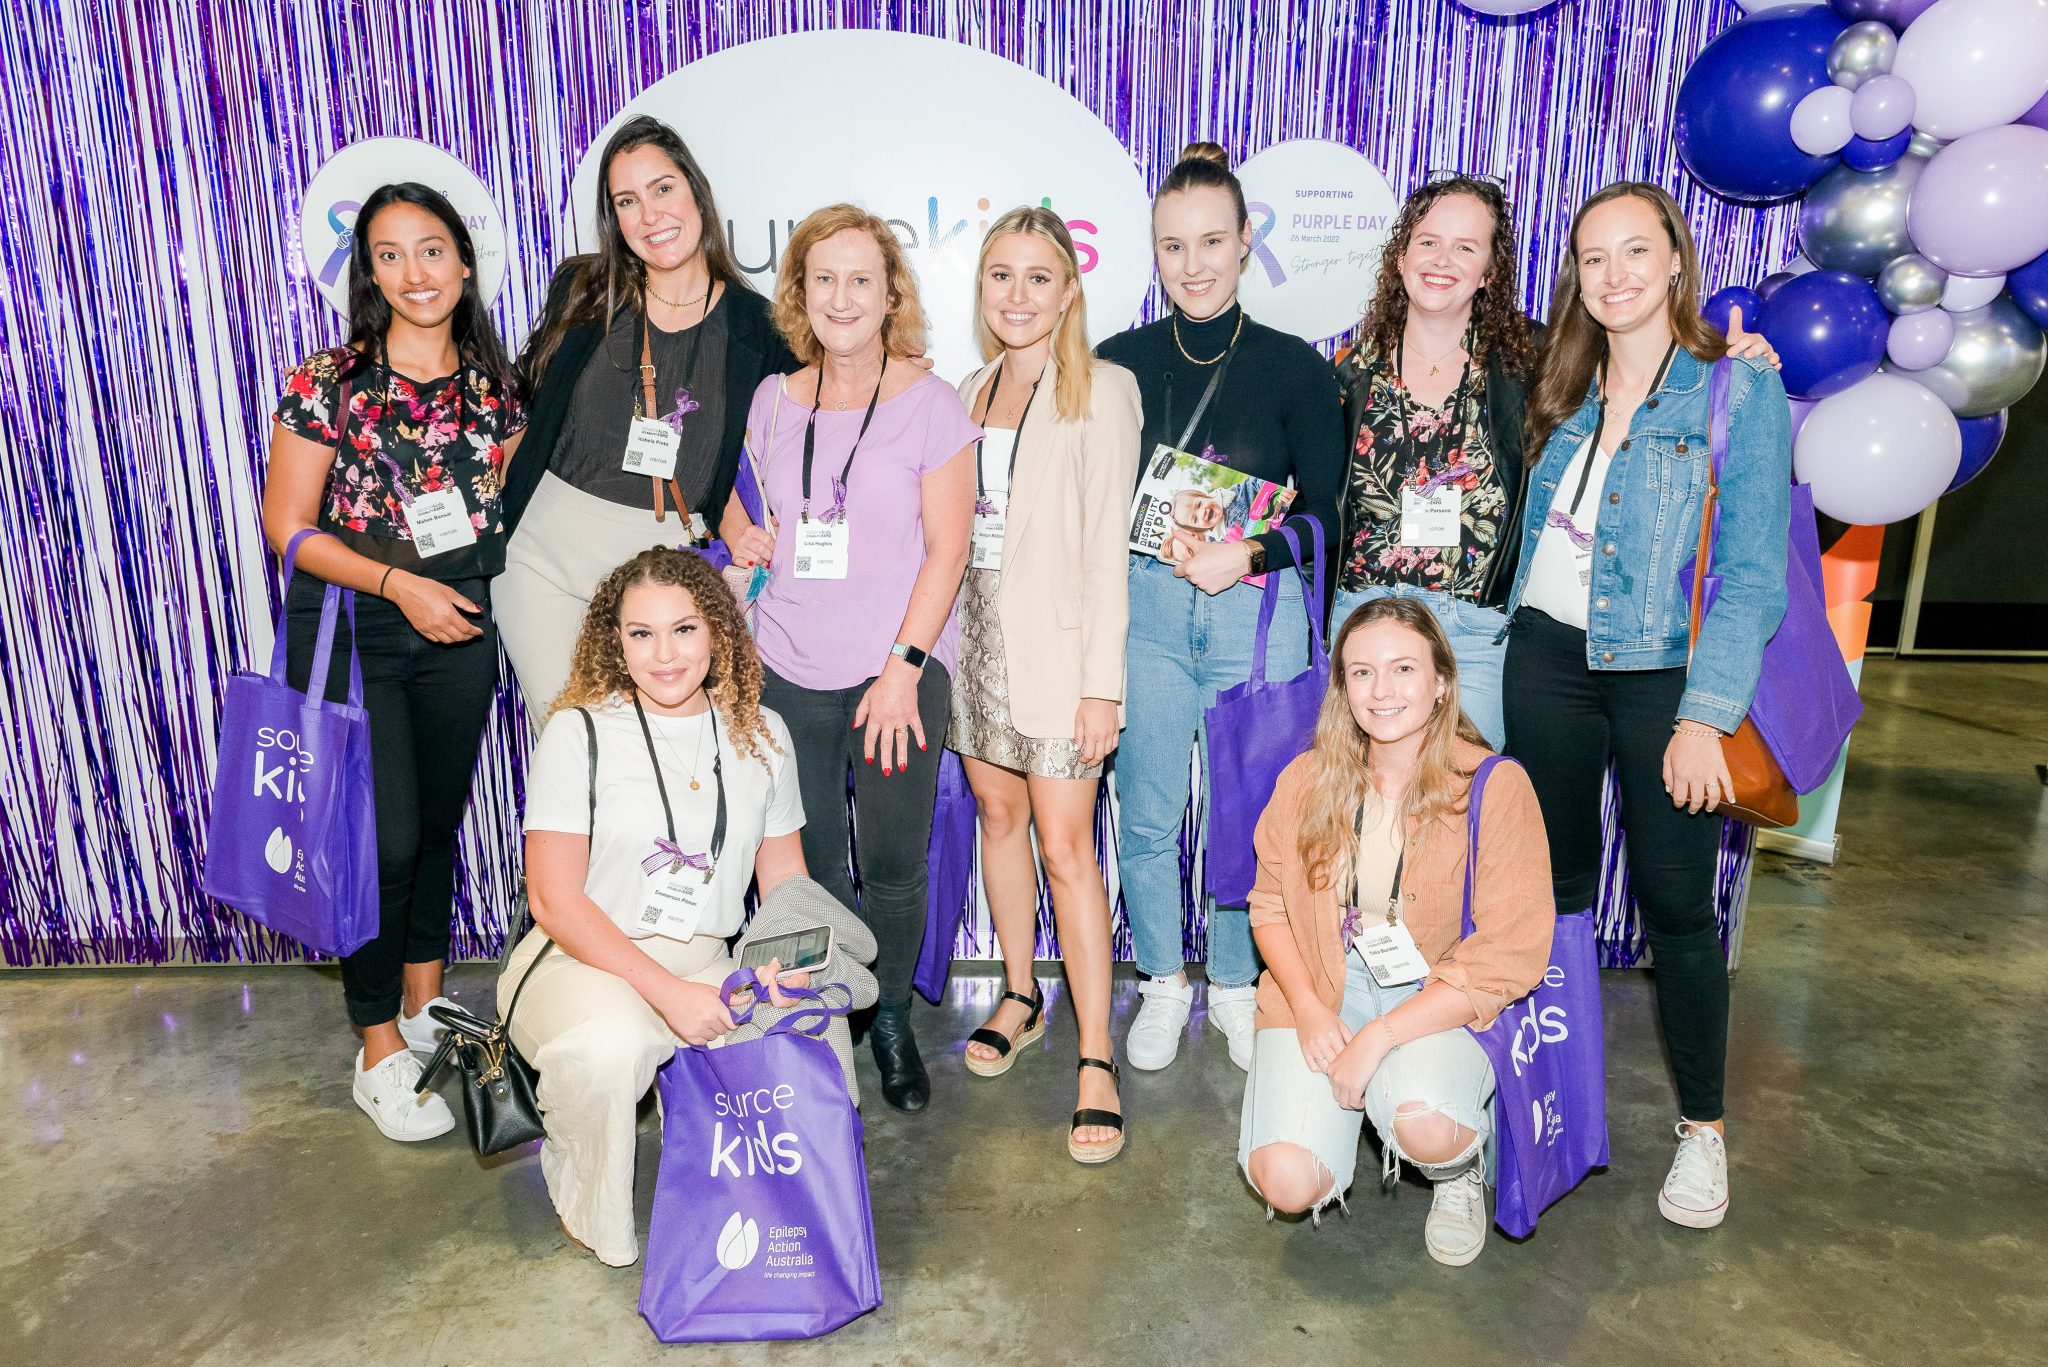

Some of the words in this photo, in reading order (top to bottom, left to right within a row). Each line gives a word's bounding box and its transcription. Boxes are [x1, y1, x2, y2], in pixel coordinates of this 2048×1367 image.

[1295, 189, 1354, 199] SUPPORTING
[1292, 213, 1353, 230] PURPLE
[1356, 215, 1388, 231] DAY
[1290, 234, 1300, 243] 26
[1301, 234, 1322, 243] March
[1322, 235, 1341, 243] 2022
[1290, 254, 1343, 275] Stronger
[1140, 496, 1160, 547] DISABILITY
[1147, 501, 1173, 550] EXPO
[710, 1119, 803, 1178] kids
[769, 1225, 808, 1241] Epilepsy
[767, 1240, 801, 1253] Action
[765, 1252, 814, 1267] Australia
